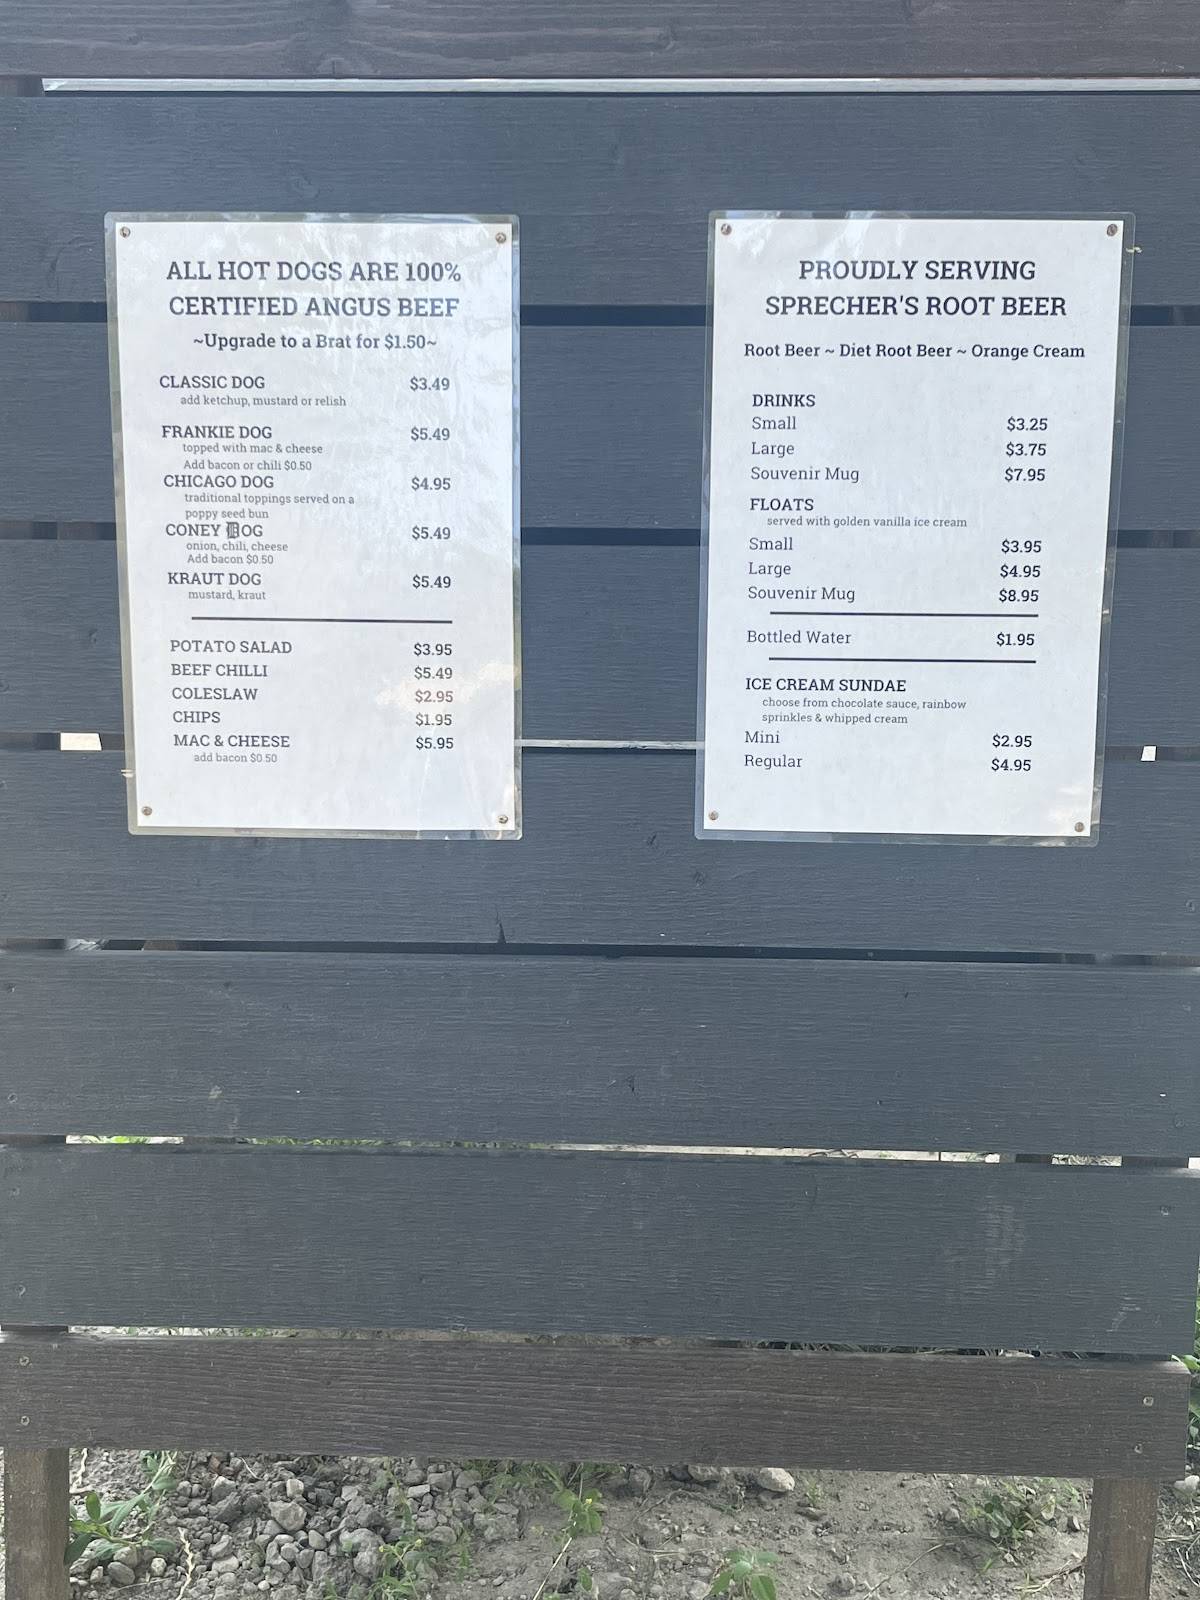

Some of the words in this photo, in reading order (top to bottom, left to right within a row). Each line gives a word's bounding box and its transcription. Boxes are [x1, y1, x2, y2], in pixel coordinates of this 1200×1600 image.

[166, 261, 211, 280] ALL
[218, 261, 270, 280] HOT
[277, 262, 342, 281] DOGS
[349, 262, 399, 281] ARE
[406, 262, 461, 282] 100%
[799, 260, 917, 280] PROUDLY
[925, 261, 1036, 281] SERVING
[169, 296, 297, 316] CERTIFIED
[305, 297, 391, 316] ANGUS
[398, 298, 460, 317] BEEF
[765, 295, 919, 316] SPRECHER'S
[926, 297, 995, 316] ROOT
[1001, 297, 1067, 316] BEER
[280, 335, 297, 348] to
[302, 338, 311, 348] a
[316, 334, 352, 349] Brat
[356, 334, 380, 349] for
[744, 344, 780, 357] Root
[785, 344, 820, 357] Beer
[839, 344, 871, 357] Diet
[876, 344, 912, 357] Root
[916, 344, 952, 358] Beer
[971, 344, 1029, 361] Orange
[1033, 345, 1085, 358] Cream
[159, 376, 227, 389] CLASSIC
[232, 376, 265, 389] DOG
[410, 376, 450, 392] $3.49
[180, 395, 200, 405] add
[203, 395, 250, 409] ketchup,
[253, 396, 298, 406] mustard
[301, 398, 312, 406] or
[315, 396, 346, 406] relish
[752, 394, 816, 407] DRINKS
[752, 416, 796, 431] Small
[1007, 417, 1048, 433] $3.25
[162, 425, 234, 439] FRANKIE
[240, 426, 272, 439] DOG
[410, 426, 450, 442] $5.49
[183, 443, 220, 455] topped
[222, 443, 247, 453] with
[249, 445, 273, 453] mac
[276, 444, 283, 453] &
[286, 443, 323, 454] cheese
[751, 442, 795, 458] Large
[1005, 442, 1047, 458] $3.75
[184, 460, 206, 470] Add
[208, 460, 240, 470] bacon
[244, 462, 254, 470] or
[257, 460, 281, 470] chili
[284, 459, 312, 472] $0.50
[164, 475, 237, 488] CHICAGO
[241, 475, 274, 488] DOG
[750, 467, 821, 481] Souvenir
[825, 468, 860, 483] Mug
[1004, 467, 1045, 483] $7.95
[411, 476, 451, 491] $4.95
[185, 493, 241, 504] traditional
[244, 494, 291, 506] toppings
[294, 494, 329, 504] served
[332, 496, 346, 504] on
[348, 496, 355, 504] a
[750, 498, 814, 511] FLOATS
[185, 510, 217, 521] poppy
[221, 508, 246, 519] seed
[248, 508, 269, 519] bun
[767, 515, 803, 527] served
[806, 515, 831, 526] with
[833, 515, 871, 529] golden
[873, 516, 911, 527] vanilla
[914, 517, 930, 527] ice
[932, 518, 967, 528] cream
[166, 524, 221, 537] CONEY
[226, 522, 263, 539] DOG
[411, 526, 451, 541] $5.49
[186, 541, 220, 553] onion,
[222, 542, 249, 553] chili,
[251, 542, 288, 552] cheese
[749, 537, 793, 551] Small
[1001, 539, 1042, 555] $3.95
[187, 554, 209, 564] Add
[211, 554, 243, 564] bacon
[246, 553, 274, 566] $0.50
[748, 561, 791, 578] Large
[1000, 564, 1041, 579] $4.95
[168, 573, 224, 585] KRAUT
[229, 573, 262, 586] DOG
[412, 575, 451, 590] $5.49
[188, 590, 235, 601] mustard,
[238, 590, 265, 600] kraut
[748, 586, 817, 600] Souvenir
[821, 587, 855, 603] Mug
[998, 588, 1039, 603] $8.95
[747, 630, 801, 644] Bottled
[806, 630, 852, 645] Water
[996, 632, 1034, 648] $1.95
[170, 640, 236, 653] POTATO
[240, 640, 292, 654] SALAD
[413, 643, 452, 658] $3.95
[171, 664, 212, 676] BEEF
[215, 664, 268, 677] CHILLI
[414, 666, 453, 681] $5.49
[745, 678, 772, 690] ICE
[776, 678, 835, 692] CREAM
[839, 679, 906, 692] SUNDAE
[172, 687, 258, 700] COLESLAW
[415, 689, 453, 704] $2.95
[762, 697, 800, 708] choose
[803, 697, 828, 708] from
[831, 698, 883, 709] chocolate
[886, 700, 920, 710] sauce,
[922, 698, 966, 709] rainbow
[173, 711, 221, 724] CHIPS
[415, 713, 452, 728] $1.95
[762, 712, 812, 726] sprinkles
[815, 714, 823, 723] &
[825, 713, 871, 727] whipped
[874, 715, 908, 724] cream
[173, 734, 210, 747] MAC
[214, 735, 224, 747] &
[228, 735, 290, 748] CHEESE
[416, 736, 454, 751] $5.95
[745, 730, 780, 744] Mini
[992, 734, 1032, 749] $2.95
[194, 753, 214, 762] add
[216, 753, 248, 763] bacon
[250, 752, 277, 764] $0.50
[744, 754, 803, 770] Regular
[991, 758, 1031, 773] $4.95
